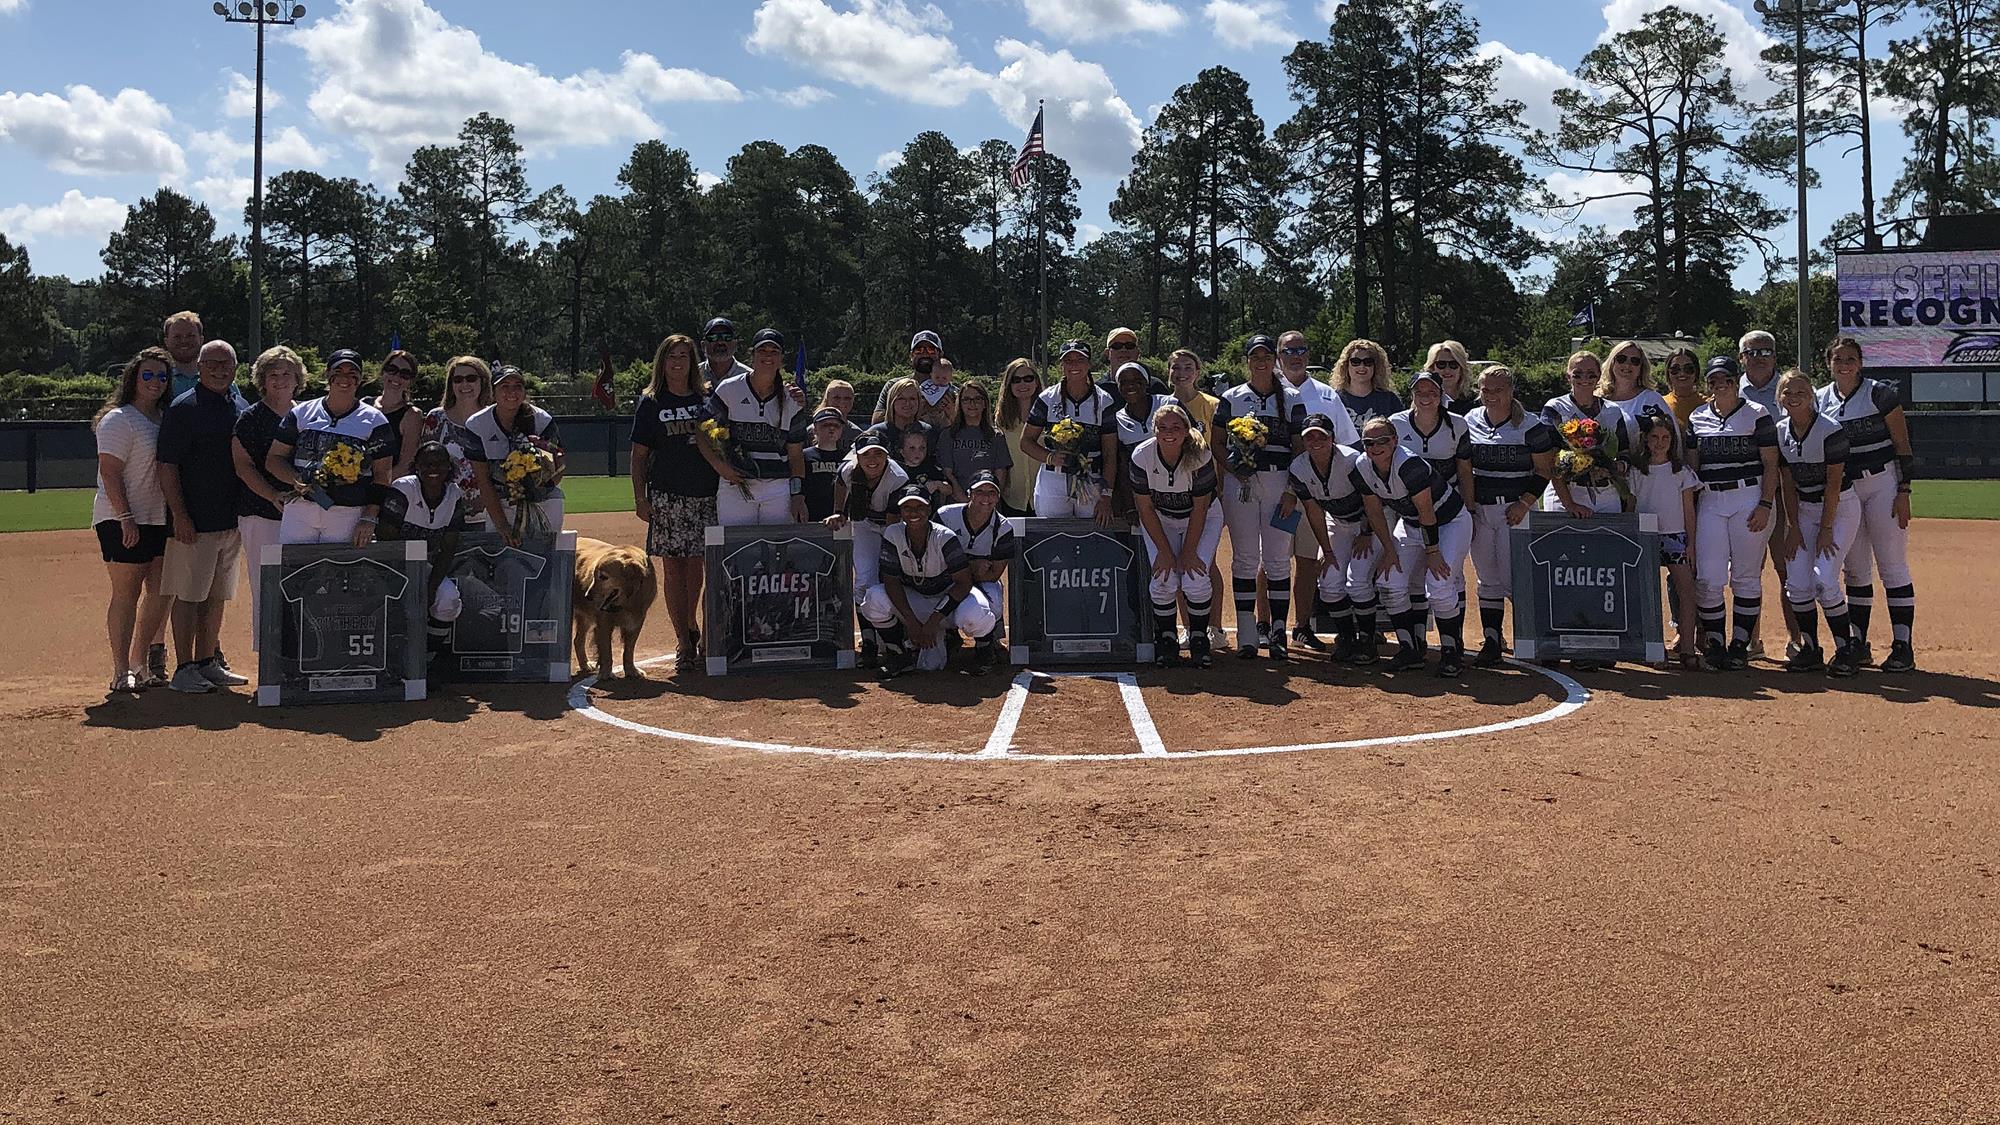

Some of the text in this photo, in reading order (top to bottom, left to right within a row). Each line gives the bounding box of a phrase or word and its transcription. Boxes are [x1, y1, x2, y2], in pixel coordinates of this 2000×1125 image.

[1893, 263, 2000, 301] SENI
[1840, 297, 2000, 327] RECOGN
[748, 573, 811, 595] EAGLES
[1050, 567, 1111, 589] EAGLES
[1554, 566, 1616, 587] EAGLES
[794, 596, 810, 619] 14
[1099, 591, 1108, 614] 7
[1603, 591, 1615, 613] 8
[499, 613, 521, 633] 19
[349, 634, 375, 656] 55
